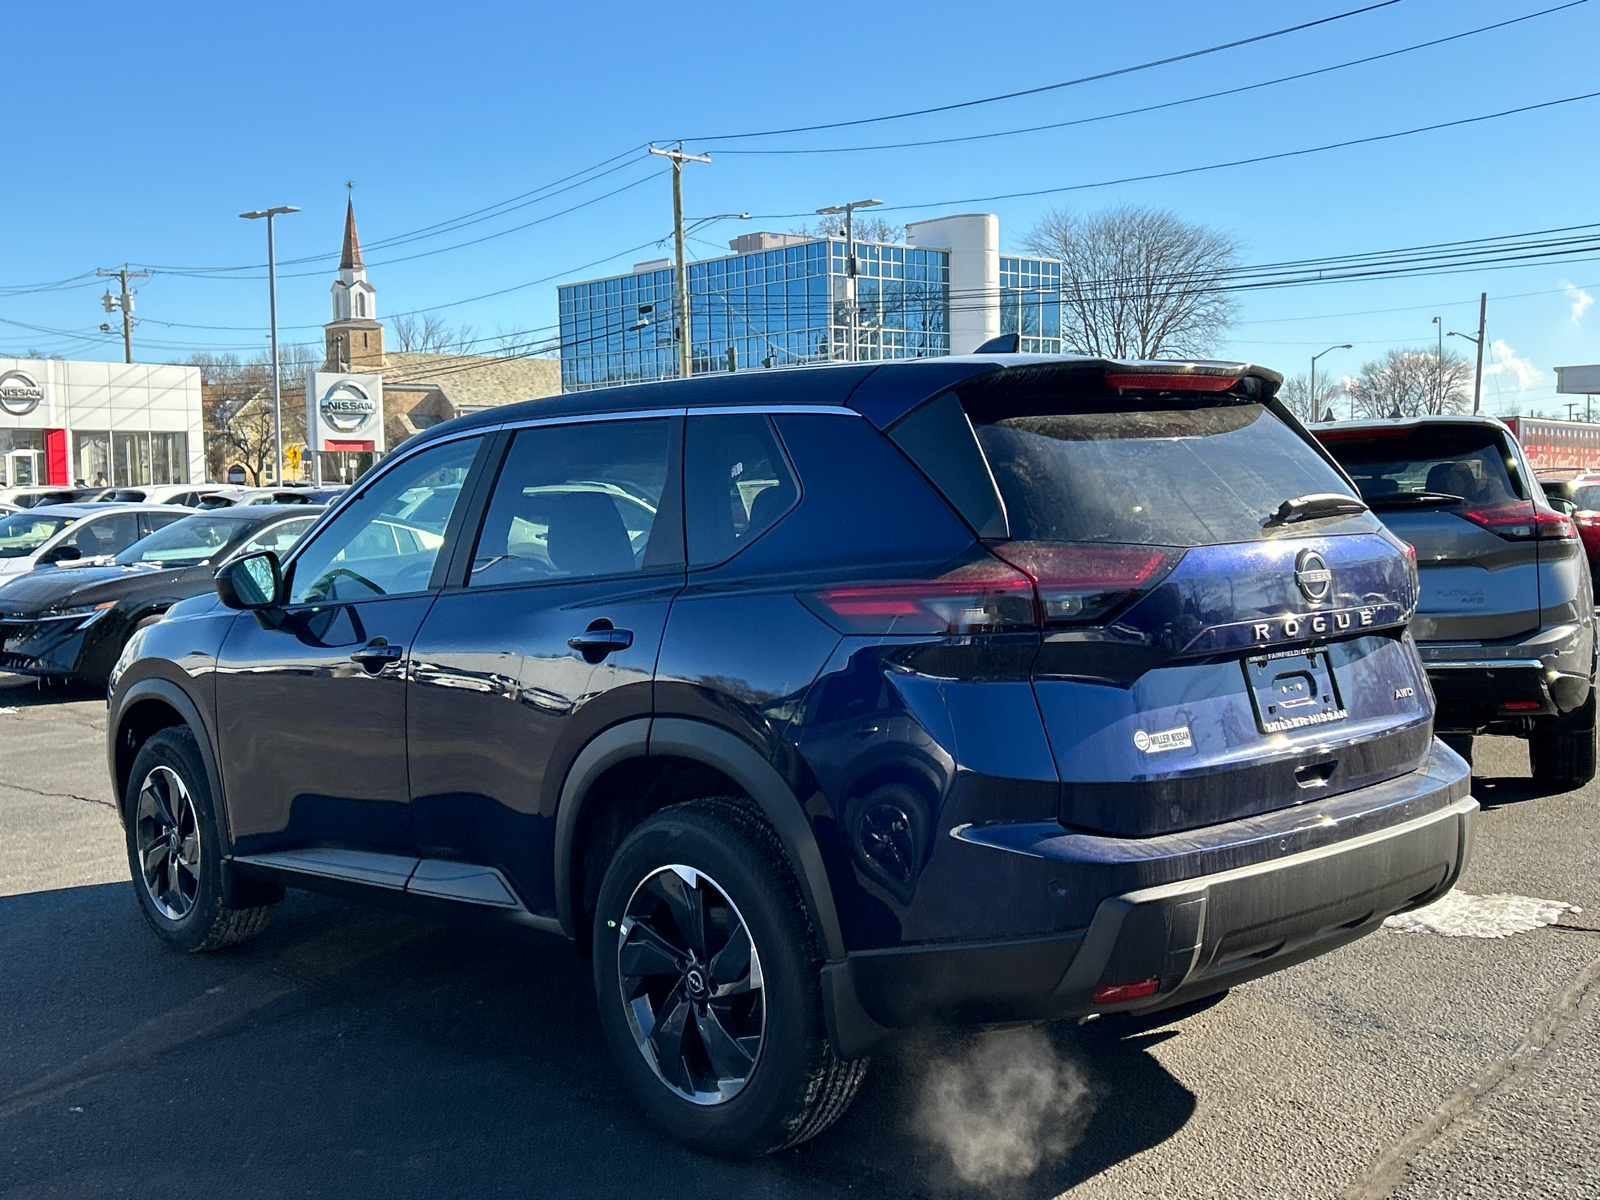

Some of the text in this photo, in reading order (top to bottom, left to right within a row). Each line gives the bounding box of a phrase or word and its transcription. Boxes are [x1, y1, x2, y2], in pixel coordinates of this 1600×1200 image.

[0, 388, 40, 396] NISSAN
[328, 401, 372, 410] NISSAN
[1300, 571, 1331, 582] NISSAN
[1255, 611, 1373, 640] ROGUE
[1395, 687, 1413, 699] AWD
[1264, 709, 1348, 733] MILLER NISSAN
[1150, 734, 1170, 745] MILLER
[1171, 731, 1189, 742] NISSAN
